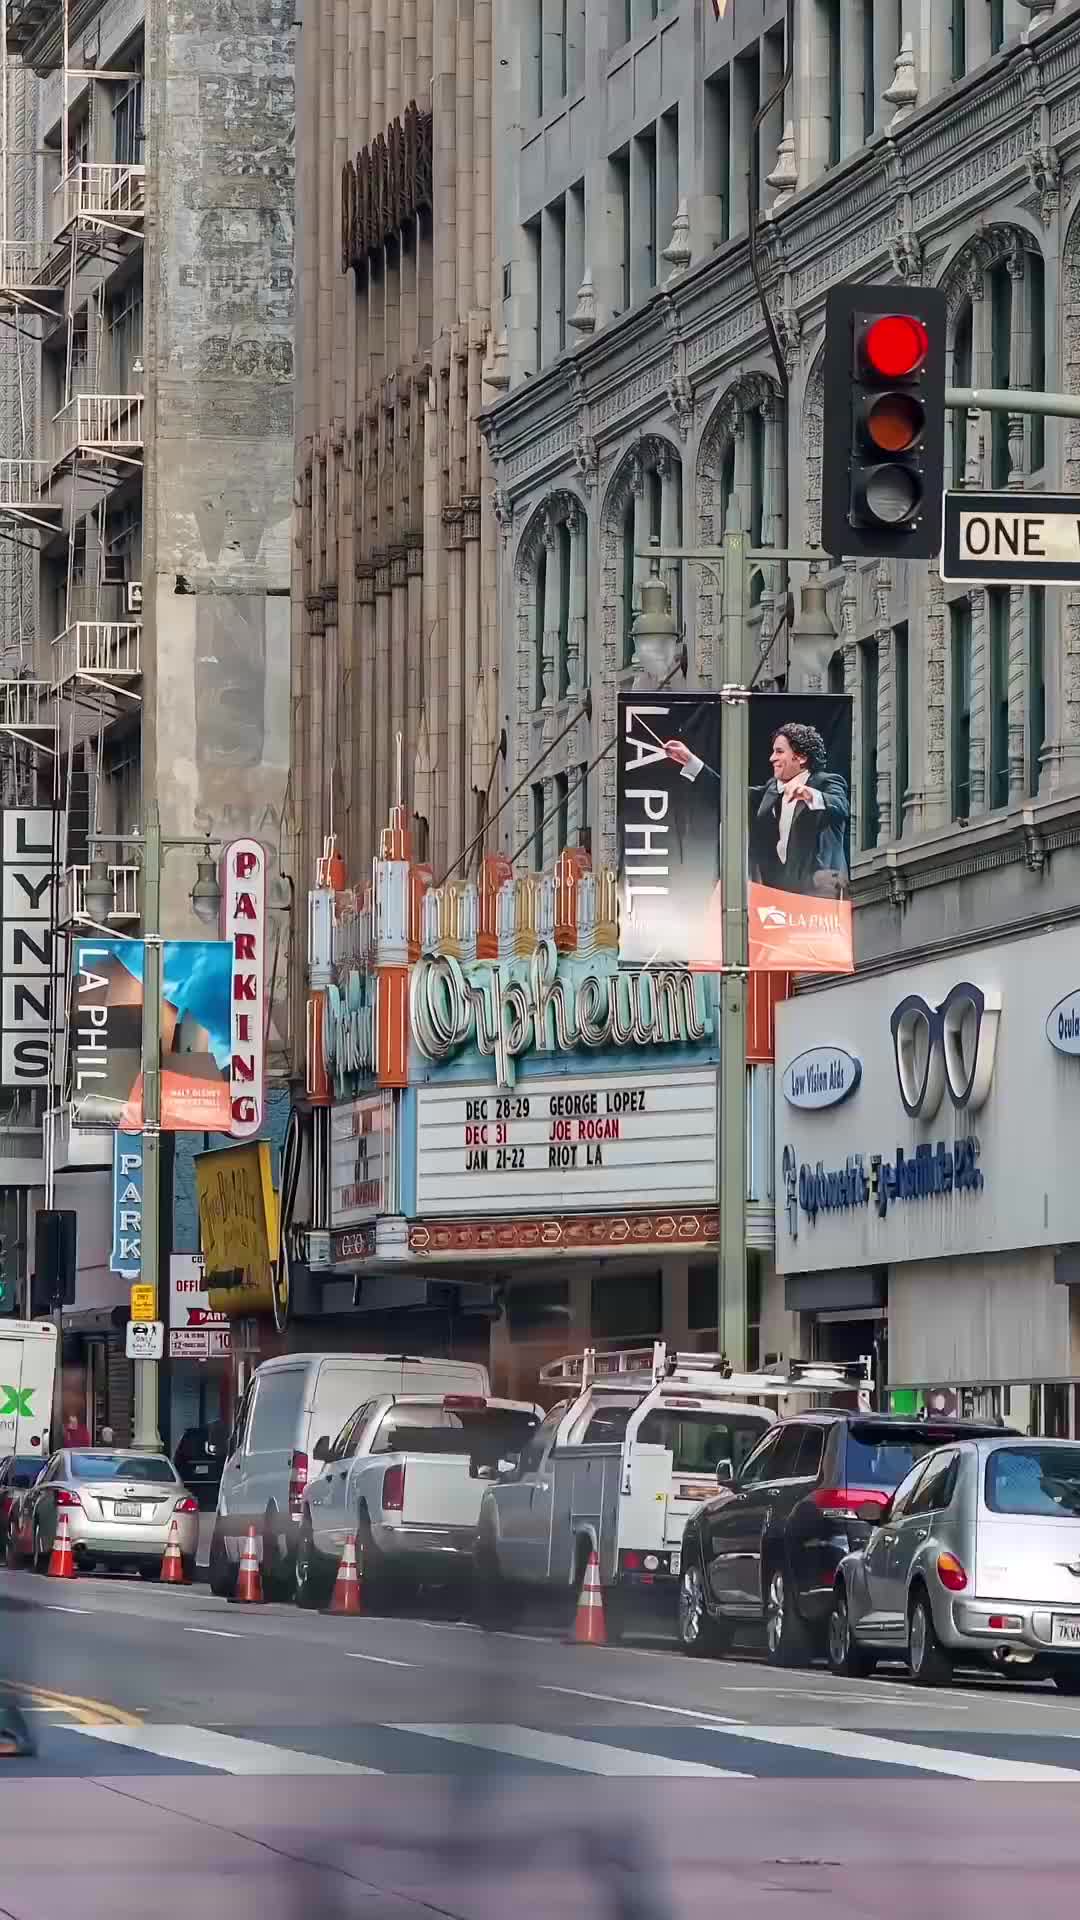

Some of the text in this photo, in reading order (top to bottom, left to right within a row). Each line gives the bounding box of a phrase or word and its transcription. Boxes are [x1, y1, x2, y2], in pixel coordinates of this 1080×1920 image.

[965, 517, 1045, 556] ONE
[624, 706, 670, 916] LA PHIL
[13, 817, 52, 1077] LYNNS
[231, 852, 258, 1122] PARKING
[77, 949, 110, 1089] LA PHIL
[410, 940, 706, 1088] Orpheum
[466, 1090, 646, 1120] DEC 28-29 GEORGE LOPEZ
[791, 1059, 844, 1096] Low Vision Aids
[465, 1119, 619, 1145] DEC 31 JOE ROGAN
[466, 1144, 603, 1170] JAN 21-22 RIOT LA
[119, 1154, 142, 1260] PARK
